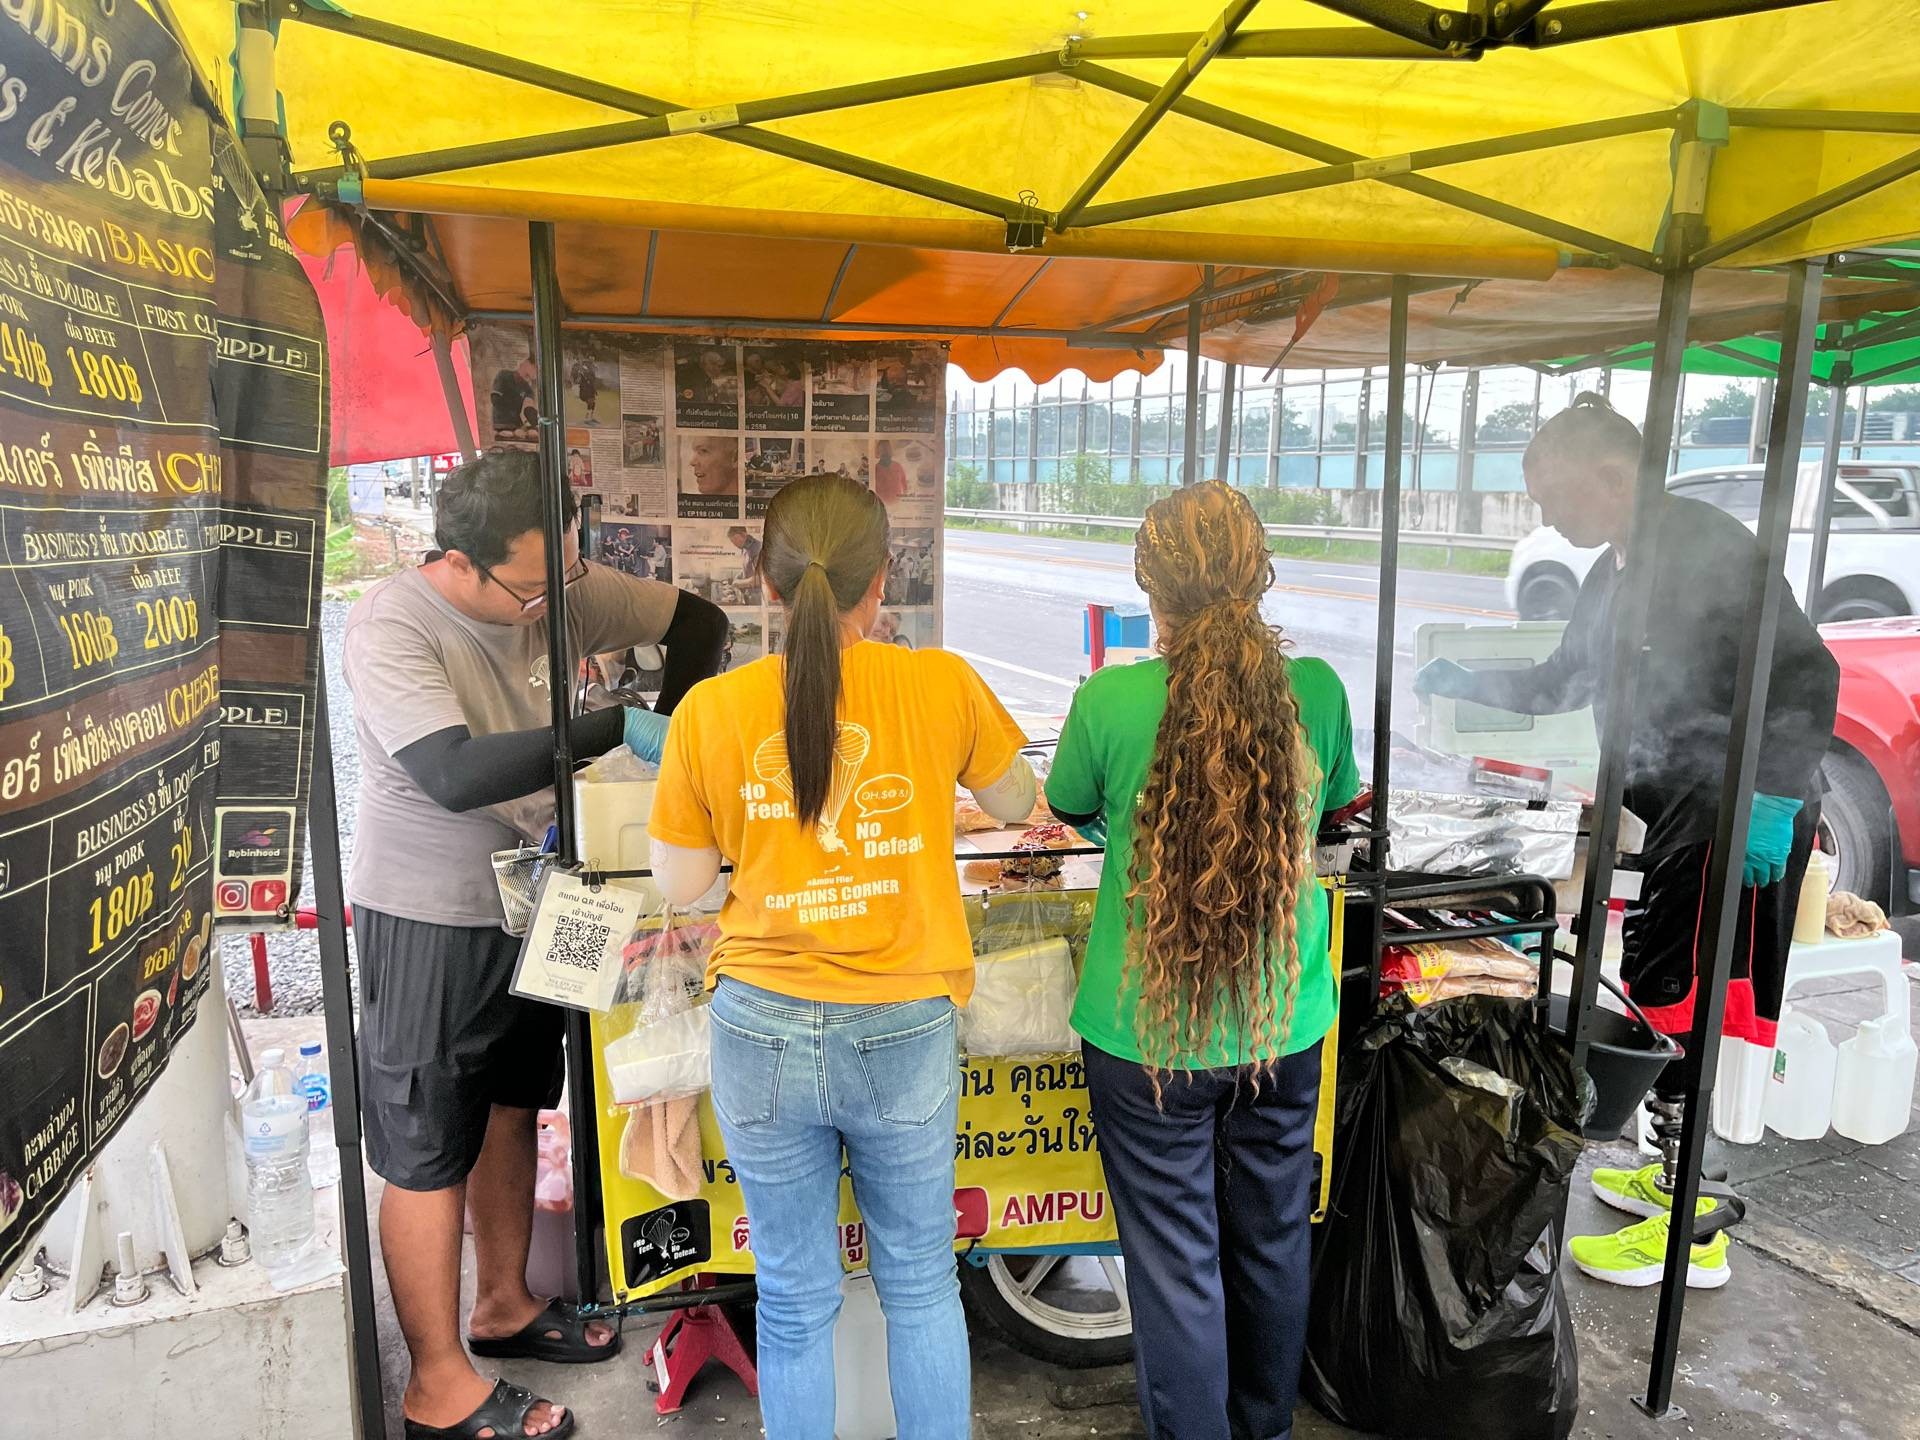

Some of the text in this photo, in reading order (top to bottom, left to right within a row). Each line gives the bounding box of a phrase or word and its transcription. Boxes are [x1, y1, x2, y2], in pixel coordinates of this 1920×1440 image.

[26, 96, 77, 157] &
[144, 303, 188, 333] FIRST
[82, 325, 118, 349] BEEF
[23, 529, 89, 562] BUSINESS
[68, 577, 94, 599] PORK
[747, 801, 795, 821] Feet,
[76, 798, 149, 860] BUSINESS
[115, 839, 145, 876] PORK
[228, 848, 281, 859] Robinhood
[581, 897, 595, 906] QR
[765, 879, 899, 909] CAPTAINS CORNER
[799, 901, 867, 924] BURGERS
[96, 1093, 127, 1138] barbecue
[26, 1121, 80, 1200] CABBAGE
[1001, 1192, 1103, 1228] AMPU
